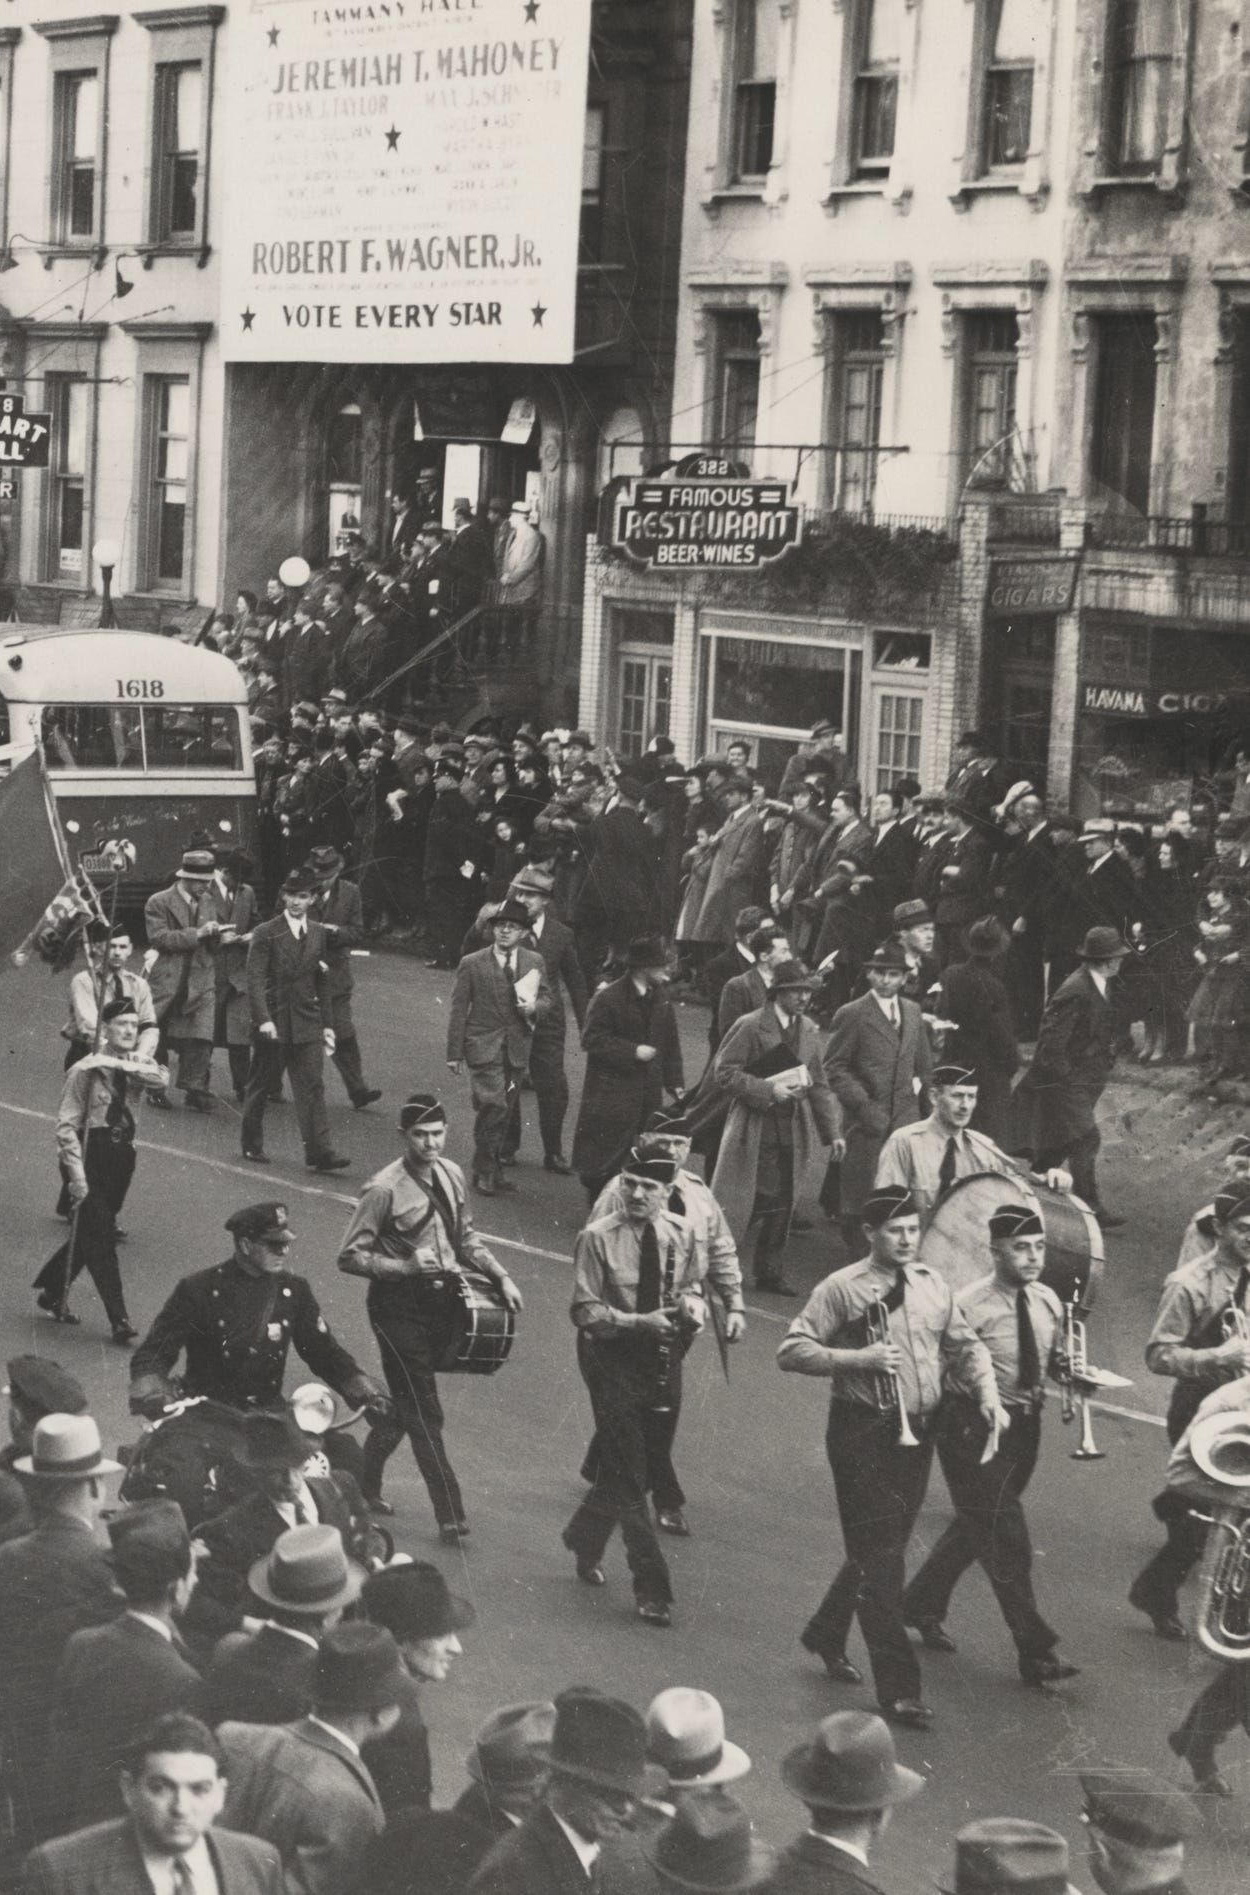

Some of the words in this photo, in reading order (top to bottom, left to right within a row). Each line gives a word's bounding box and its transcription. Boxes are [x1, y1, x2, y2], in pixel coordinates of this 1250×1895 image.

[312, 1, 406, 25] TAMMANY
[272, 51, 402, 95] JEREMIAH
[414, 50, 431, 83] T.
[437, 37, 565, 80] MAHONEY
[267, 99, 314, 122] FRANK
[333, 94, 390, 119] TAYLOR
[252, 239, 353, 275] ROBERT
[360, 238, 382, 274] F.
[282, 304, 343, 329] VOTE
[354, 303, 440, 329] EVERY
[449, 301, 503, 327] STAR
[697, 460, 729, 476] 322
[669, 487, 754, 507] FAMOUS
[624, 510, 792, 541] RESTAURANT
[991, 584, 1070, 607] CIGARS
[116, 679, 164, 700] 1618
[1085, 686, 1147, 714] HAVANA
